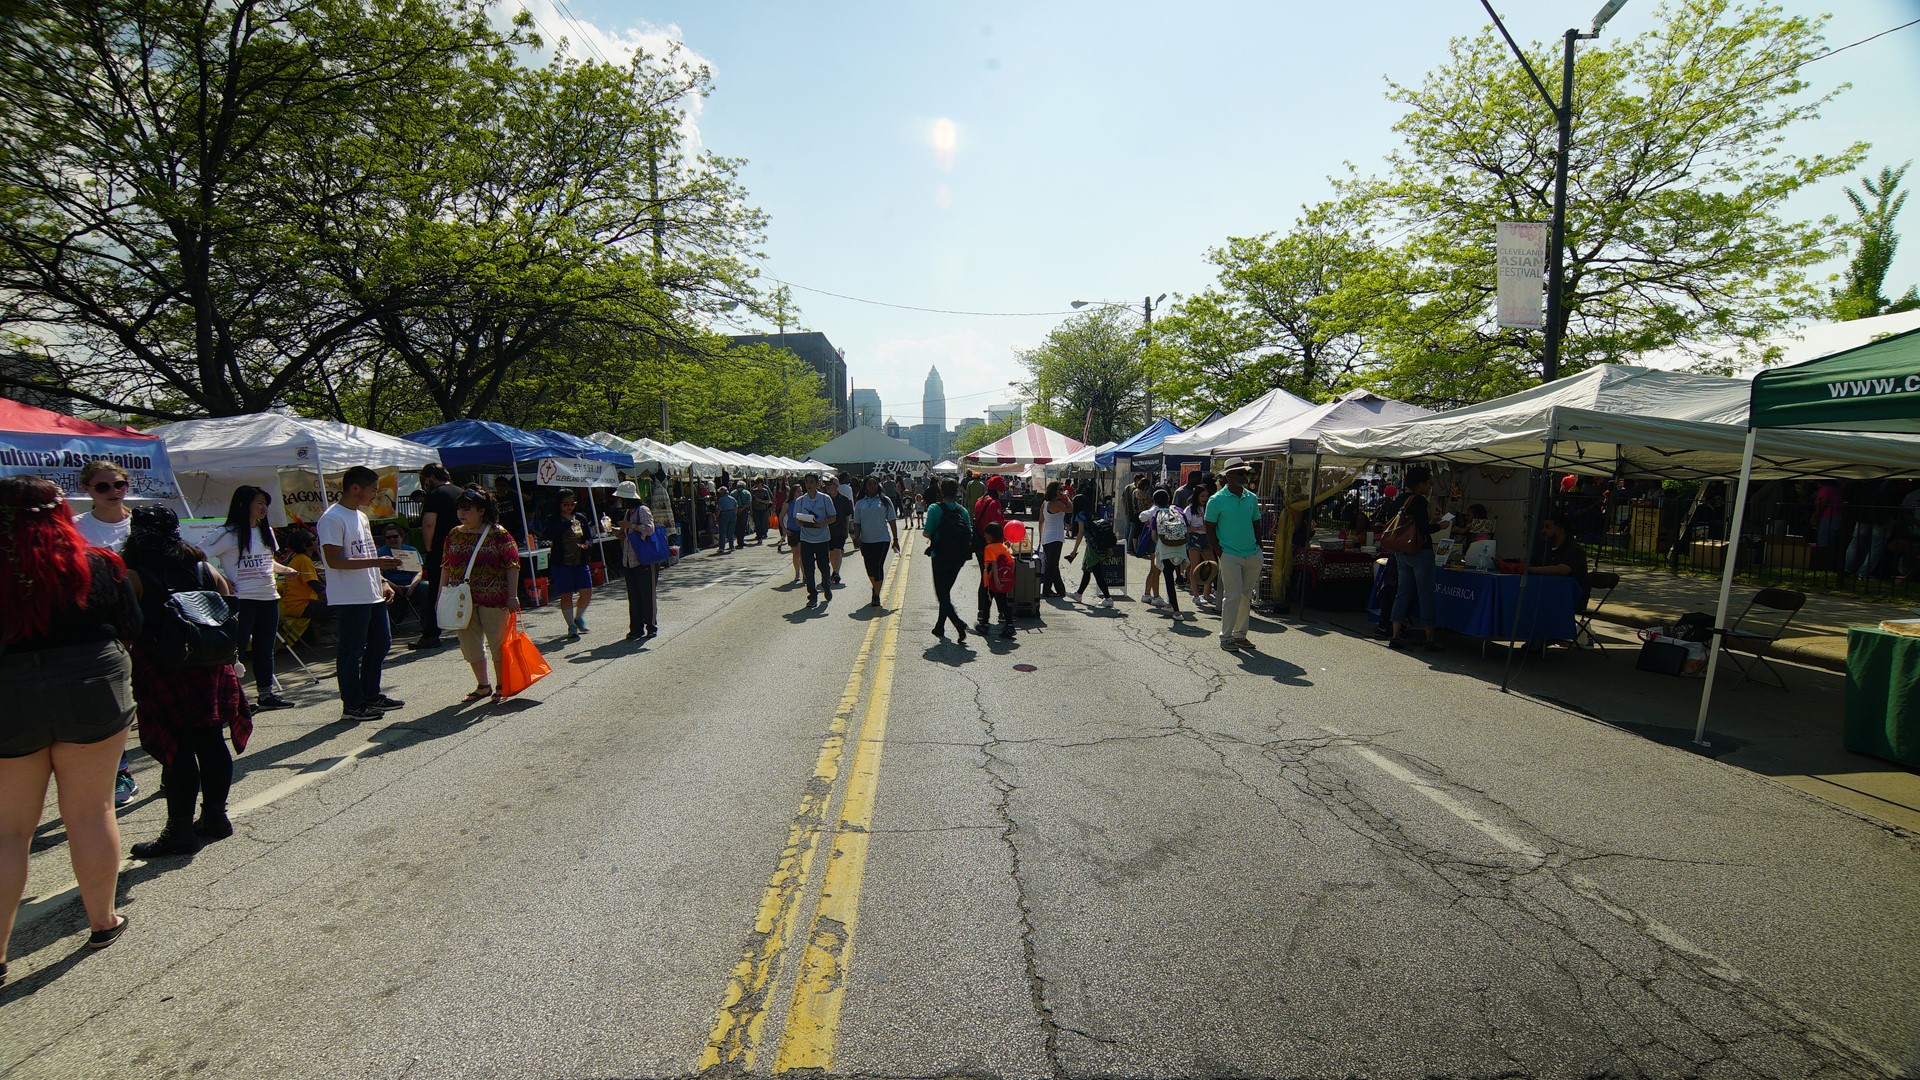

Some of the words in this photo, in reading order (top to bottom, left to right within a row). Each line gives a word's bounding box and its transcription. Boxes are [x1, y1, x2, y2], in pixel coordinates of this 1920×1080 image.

[1499, 248, 1544, 256] CLEVELAND
[1500, 256, 1544, 267] ASIAN
[1499, 267, 1542, 278] FESTIVAL
[1827, 375, 1920, 398] www.c
[555, 474, 580, 483] CLEVELAND
[282, 490, 323, 506] RAGON
[243, 559, 264, 568] VOTE
[1441, 585, 1475, 600] AMERICA
